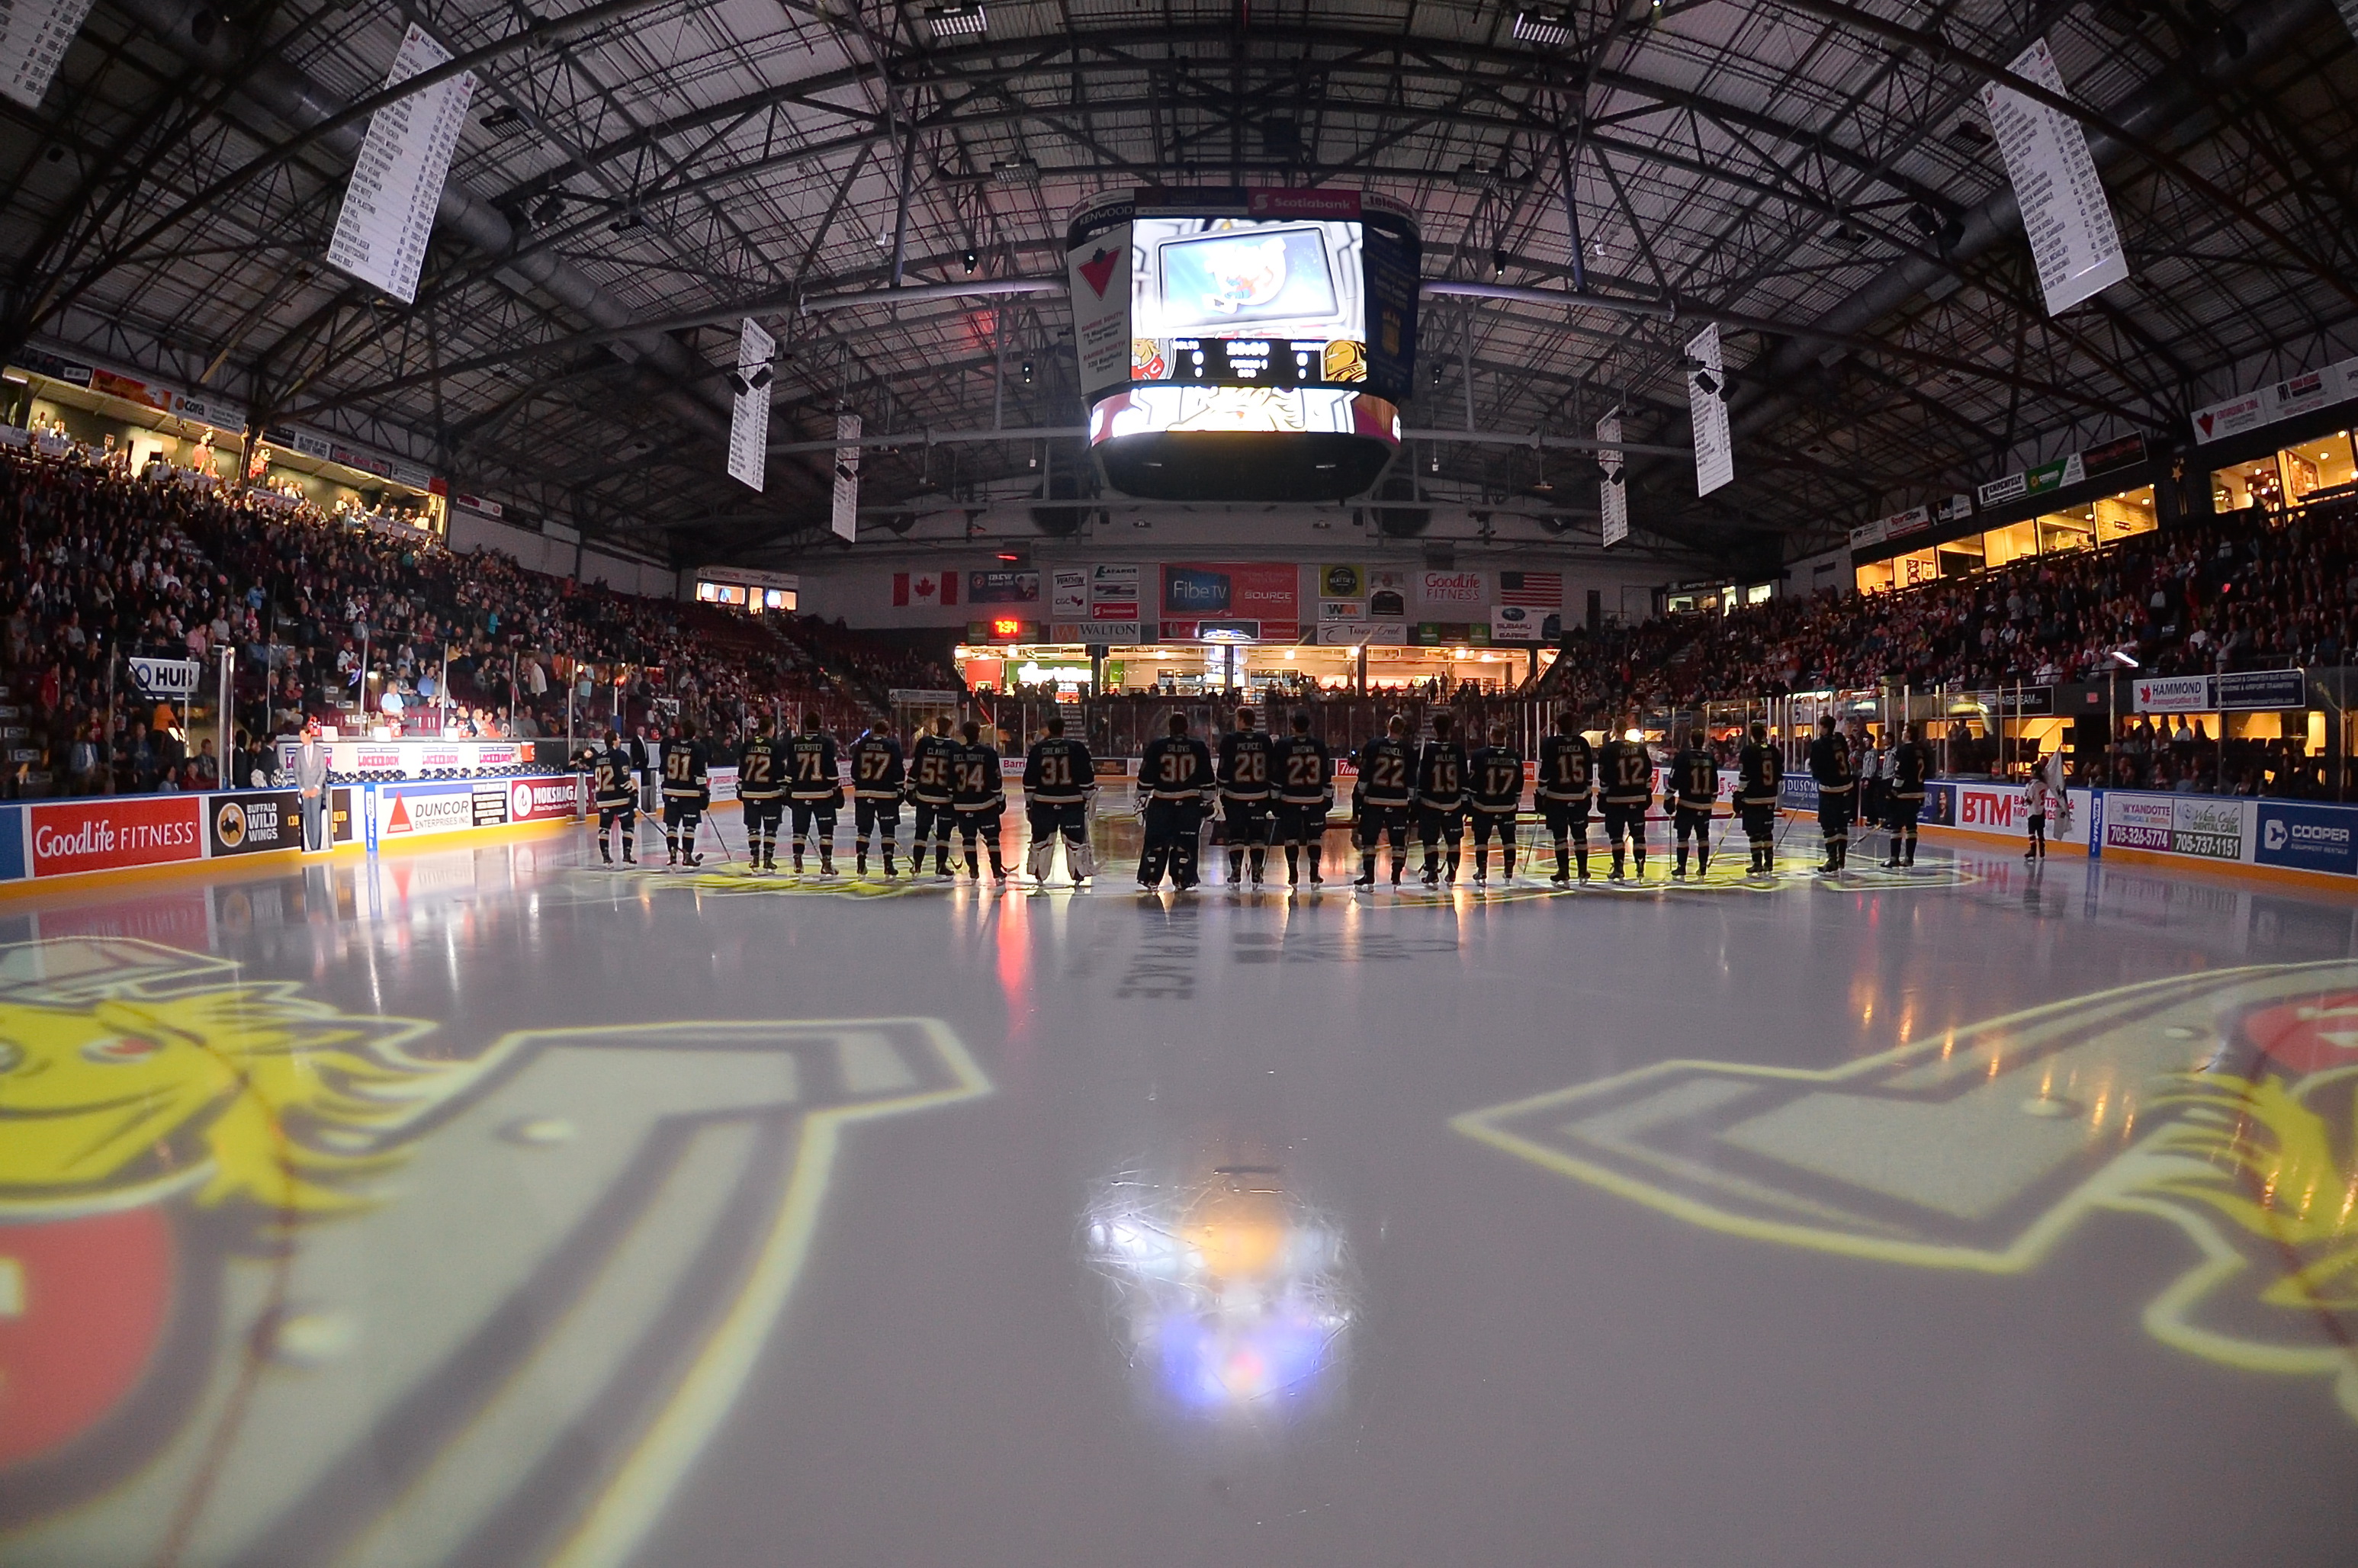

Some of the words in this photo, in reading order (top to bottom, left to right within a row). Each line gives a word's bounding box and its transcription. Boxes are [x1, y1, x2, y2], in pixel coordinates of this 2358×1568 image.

[1274, 198, 1351, 210] Scotiabank
[1079, 206, 1133, 227] KENWOOD
[185, 400, 204, 416] cora
[1056, 577, 1084, 585] WATSON
[1173, 580, 1210, 599] Fibe
[1212, 585, 1227, 599] TV
[1425, 573, 1480, 588] GoodLife
[1244, 591, 1293, 600] SOURCE
[1427, 588, 1479, 601] FITNESS
[1080, 623, 1136, 636] WALTON
[156, 667, 193, 687] HUB
[2152, 682, 2202, 696] HAMMOND
[667, 753, 691, 782] 91
[745, 754, 771, 783] 72
[795, 752, 824, 782] 71
[860, 752, 891, 781] 57
[920, 756, 949, 786] 55
[1003, 759, 1026, 768] Barri
[1040, 756, 1072, 786] 31
[1159, 753, 1197, 783] 30
[1234, 752, 1267, 782] 28
[1286, 755, 1322, 786] 23
[1373, 757, 1405, 789] 22
[1556, 753, 1586, 785] 15
[1616, 757, 1646, 786] 12
[1762, 760, 1774, 786] 9
[595, 765, 615, 792] 92
[954, 763, 985, 793] 34
[1431, 763, 1459, 793] 19
[1486, 766, 1516, 795] 17
[1690, 766, 1711, 795] 11
[246, 802, 278, 815] BUFFALO
[415, 800, 470, 818] DUNCOR
[1962, 792, 2012, 827] BTM
[2123, 802, 2171, 817] WYANDOTTE
[246, 811, 278, 830] WILD
[415, 817, 458, 830] ENTERPRISES
[2193, 821, 2219, 832] DENTAL
[35, 819, 115, 859] GoodLife
[120, 821, 195, 850] FITNESS
[248, 827, 278, 842] WINGS
[2110, 825, 2169, 848] 705-326-5774
[2292, 824, 2350, 843] COOPER
[2175, 834, 2239, 857] 705-737-1151
[1115, 945, 1200, 1000] PLACE
